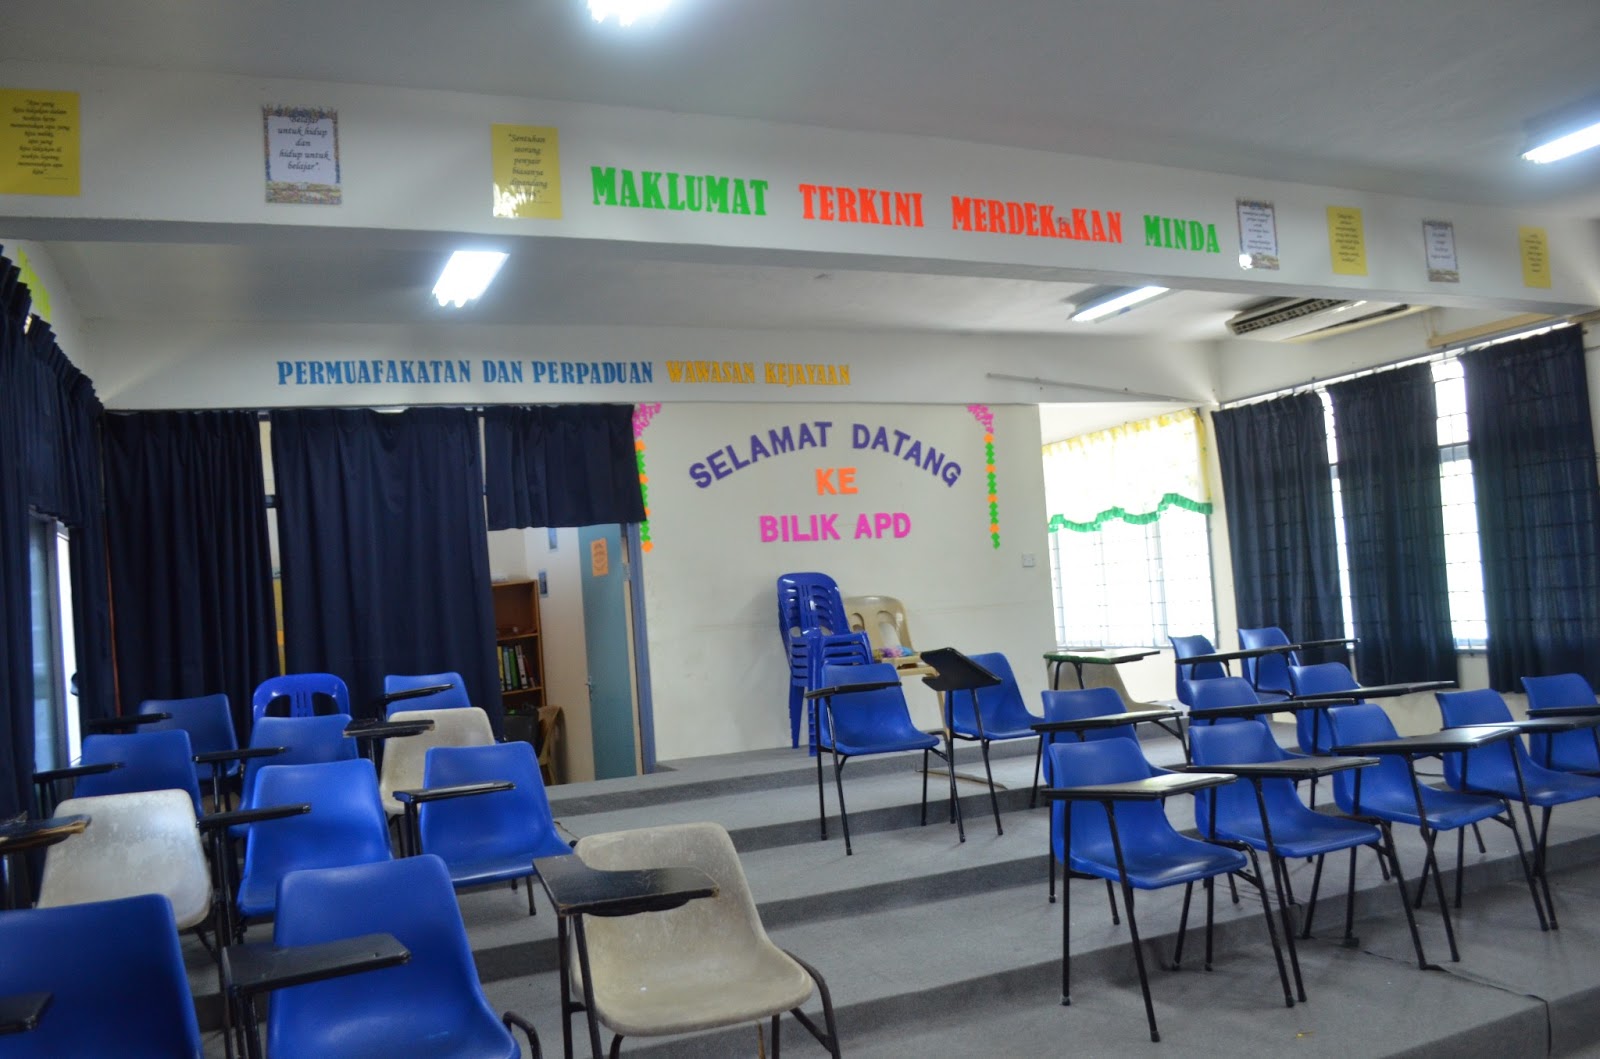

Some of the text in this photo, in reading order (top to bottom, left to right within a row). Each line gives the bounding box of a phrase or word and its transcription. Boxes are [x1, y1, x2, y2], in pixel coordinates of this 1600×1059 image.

[277, 126, 328, 138] untuk hidup
[295, 138, 311, 147] dan
[279, 149, 331, 161] hidup untuk
[590, 166, 1221, 253] MAKLUMAT TERKINI MERDEKAKAN MINDA
[276, 360, 851, 387] PERMUAFAKATAN DAN PERPADUAN WAWASAN KEJAYAAN
[689, 421, 962, 489] SELAMAT DATANG
[815, 467, 859, 496] KE
[759, 512, 912, 543] BILIK APD
